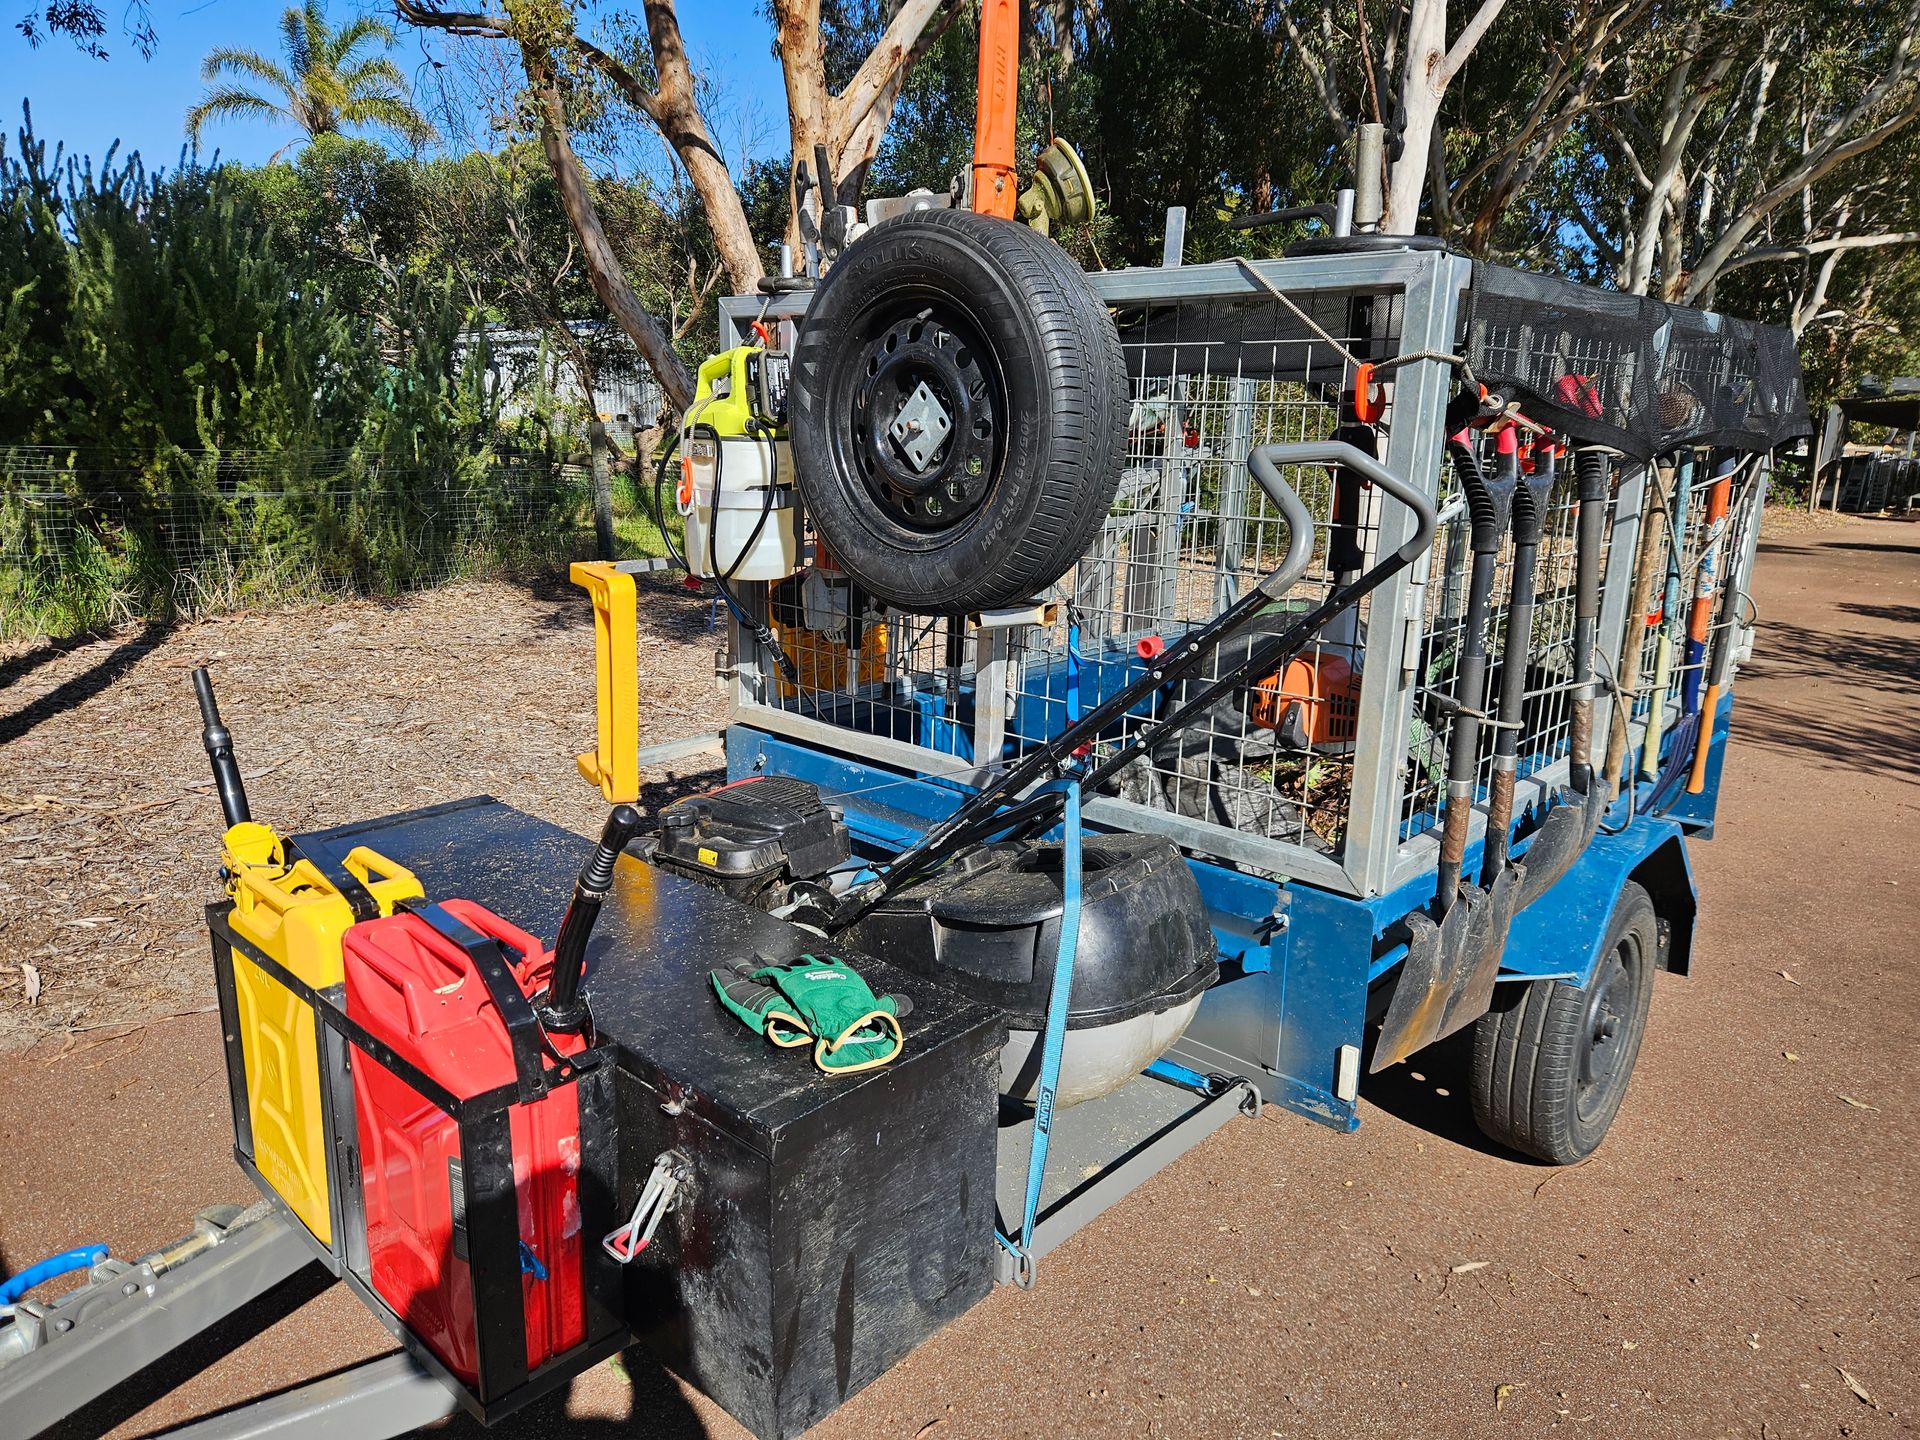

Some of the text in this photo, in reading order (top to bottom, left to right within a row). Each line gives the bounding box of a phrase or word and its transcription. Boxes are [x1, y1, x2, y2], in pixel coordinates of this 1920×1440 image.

[849, 242, 924, 277] SOLUS
[1014, 410, 1030, 480] 205/65
[1001, 482, 1021, 519] R15
[980, 516, 1005, 552] 94H
[1039, 1091, 1052, 1129] GRUNT
